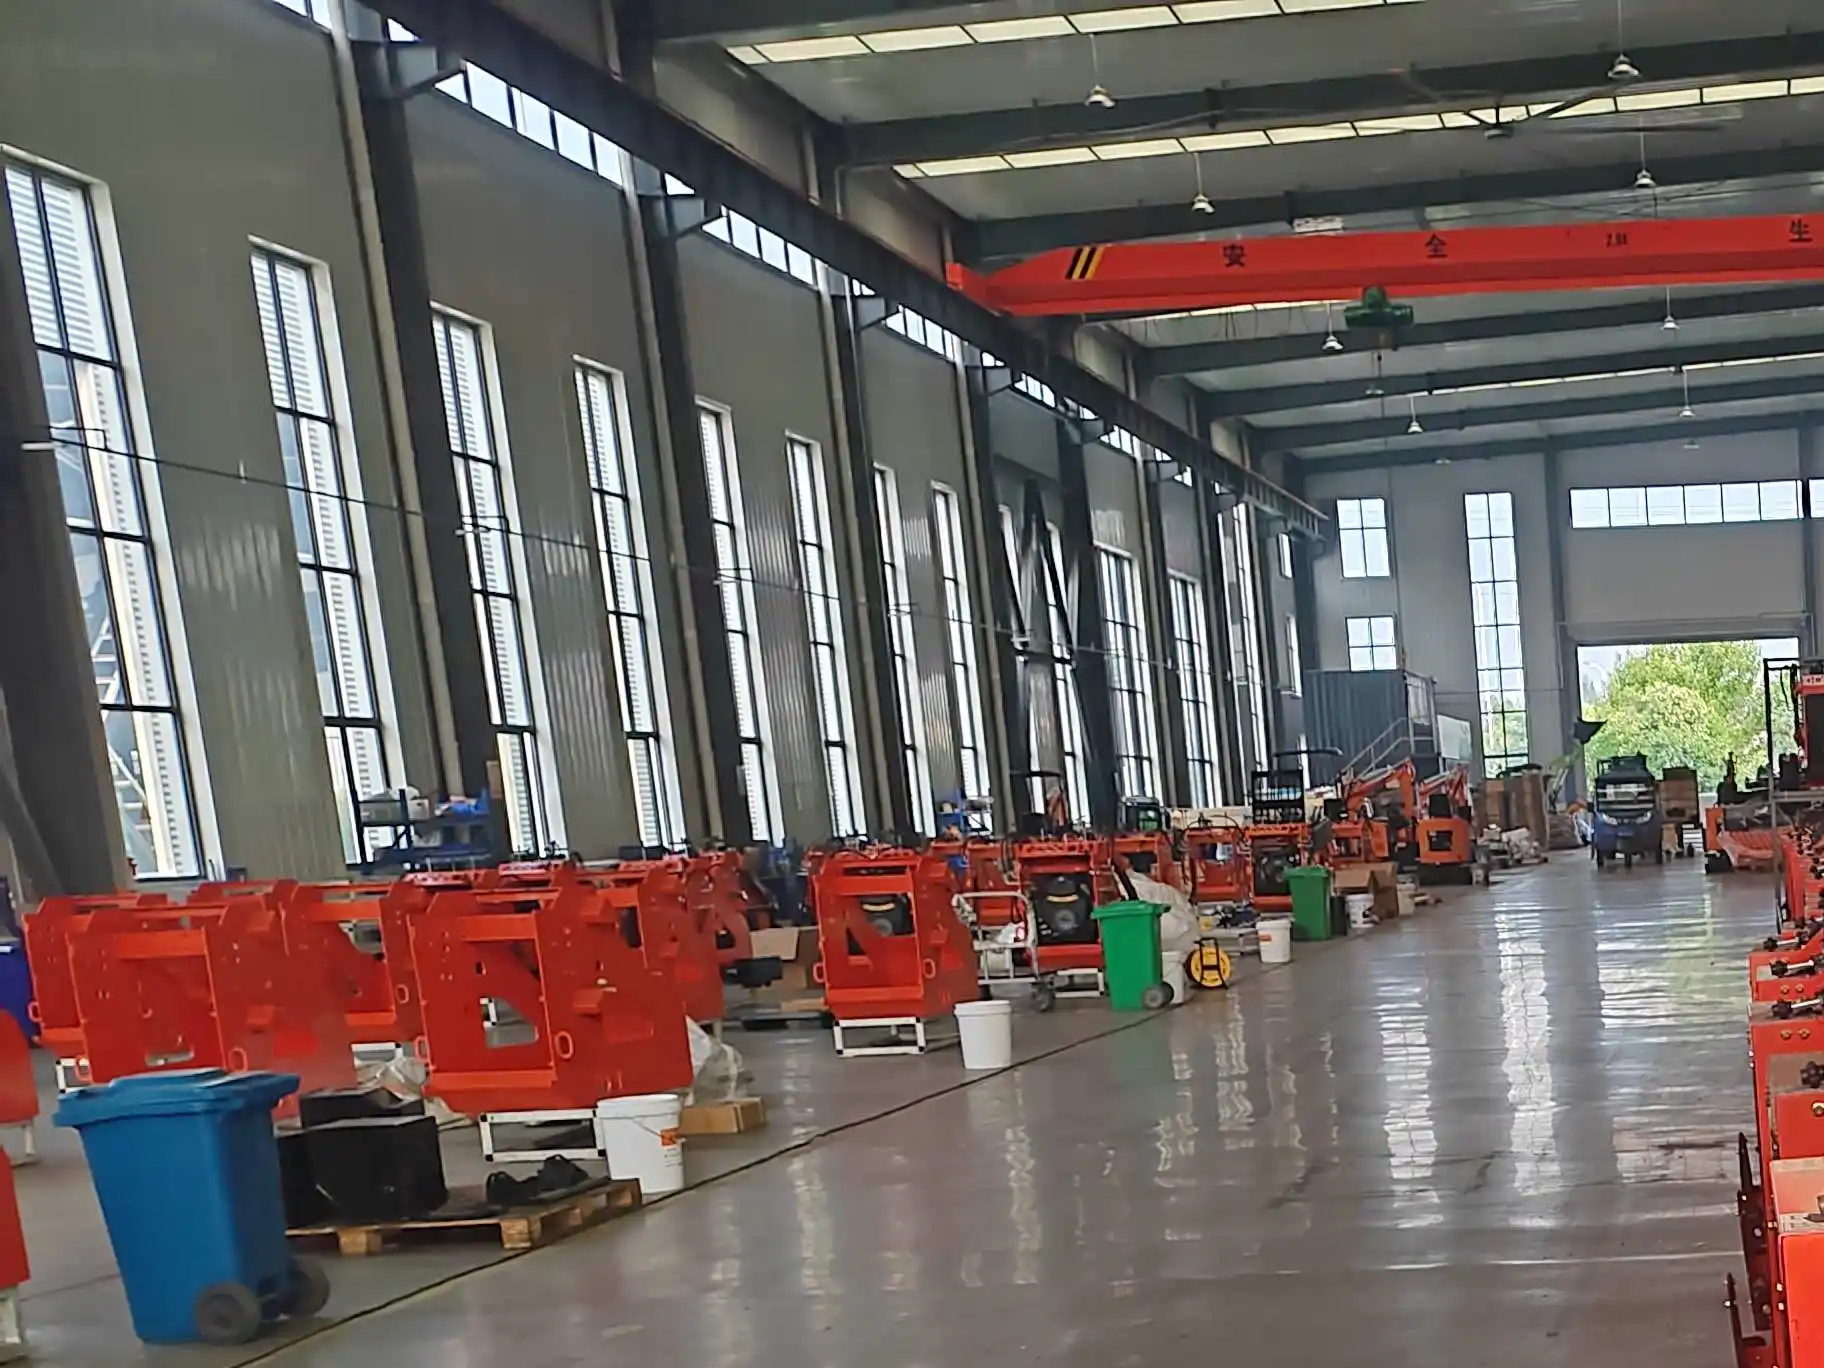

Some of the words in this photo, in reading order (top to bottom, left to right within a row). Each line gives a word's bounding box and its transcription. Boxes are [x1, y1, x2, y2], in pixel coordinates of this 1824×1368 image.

[1222, 243, 1246, 267] 安
[1424, 232, 1448, 258] 全
[1788, 217, 1814, 242] 生
